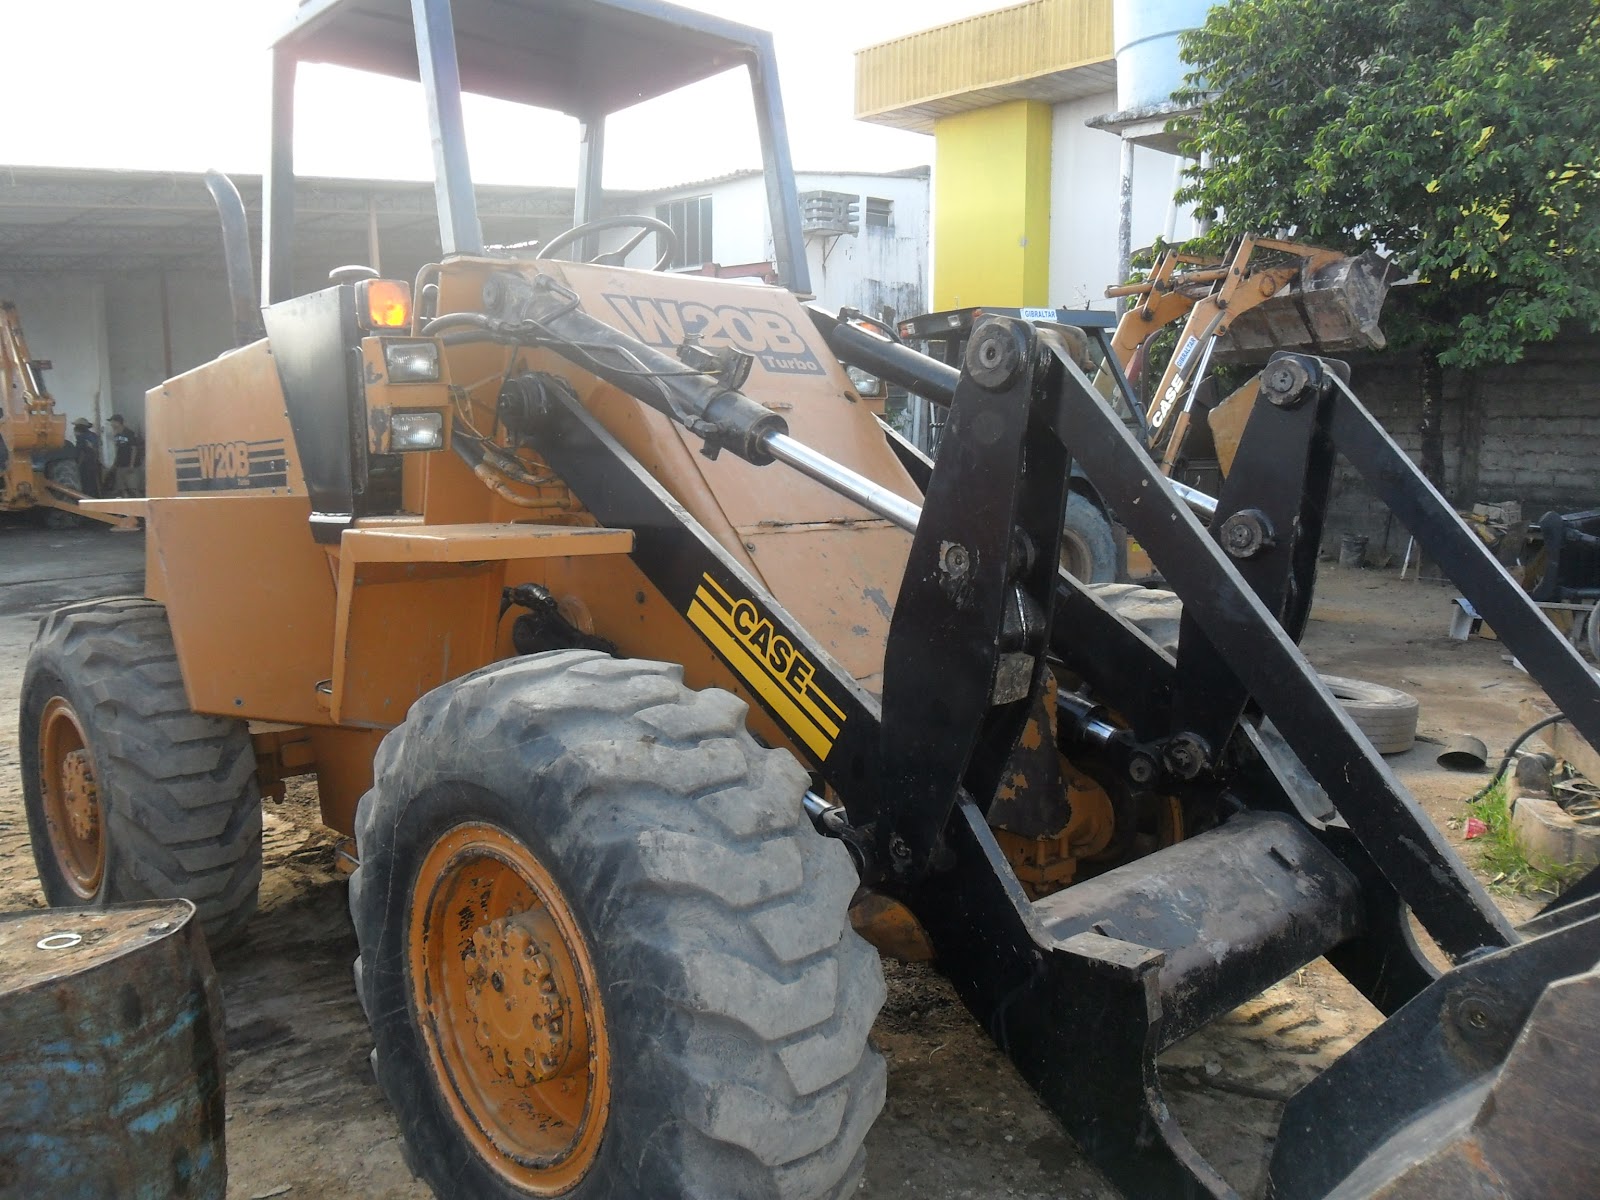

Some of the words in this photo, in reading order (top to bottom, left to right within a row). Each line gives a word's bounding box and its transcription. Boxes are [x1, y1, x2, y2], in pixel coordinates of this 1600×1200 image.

[604, 295, 806, 354] W20B
[1025, 310, 1055, 318] GIBRALTAR
[762, 355, 818, 370] Turbo
[1177, 337, 1197, 367] GIBRALTAR
[1152, 373, 1184, 427] CASE
[198, 442, 250, 479] W20B
[733, 602, 811, 695] CASE
